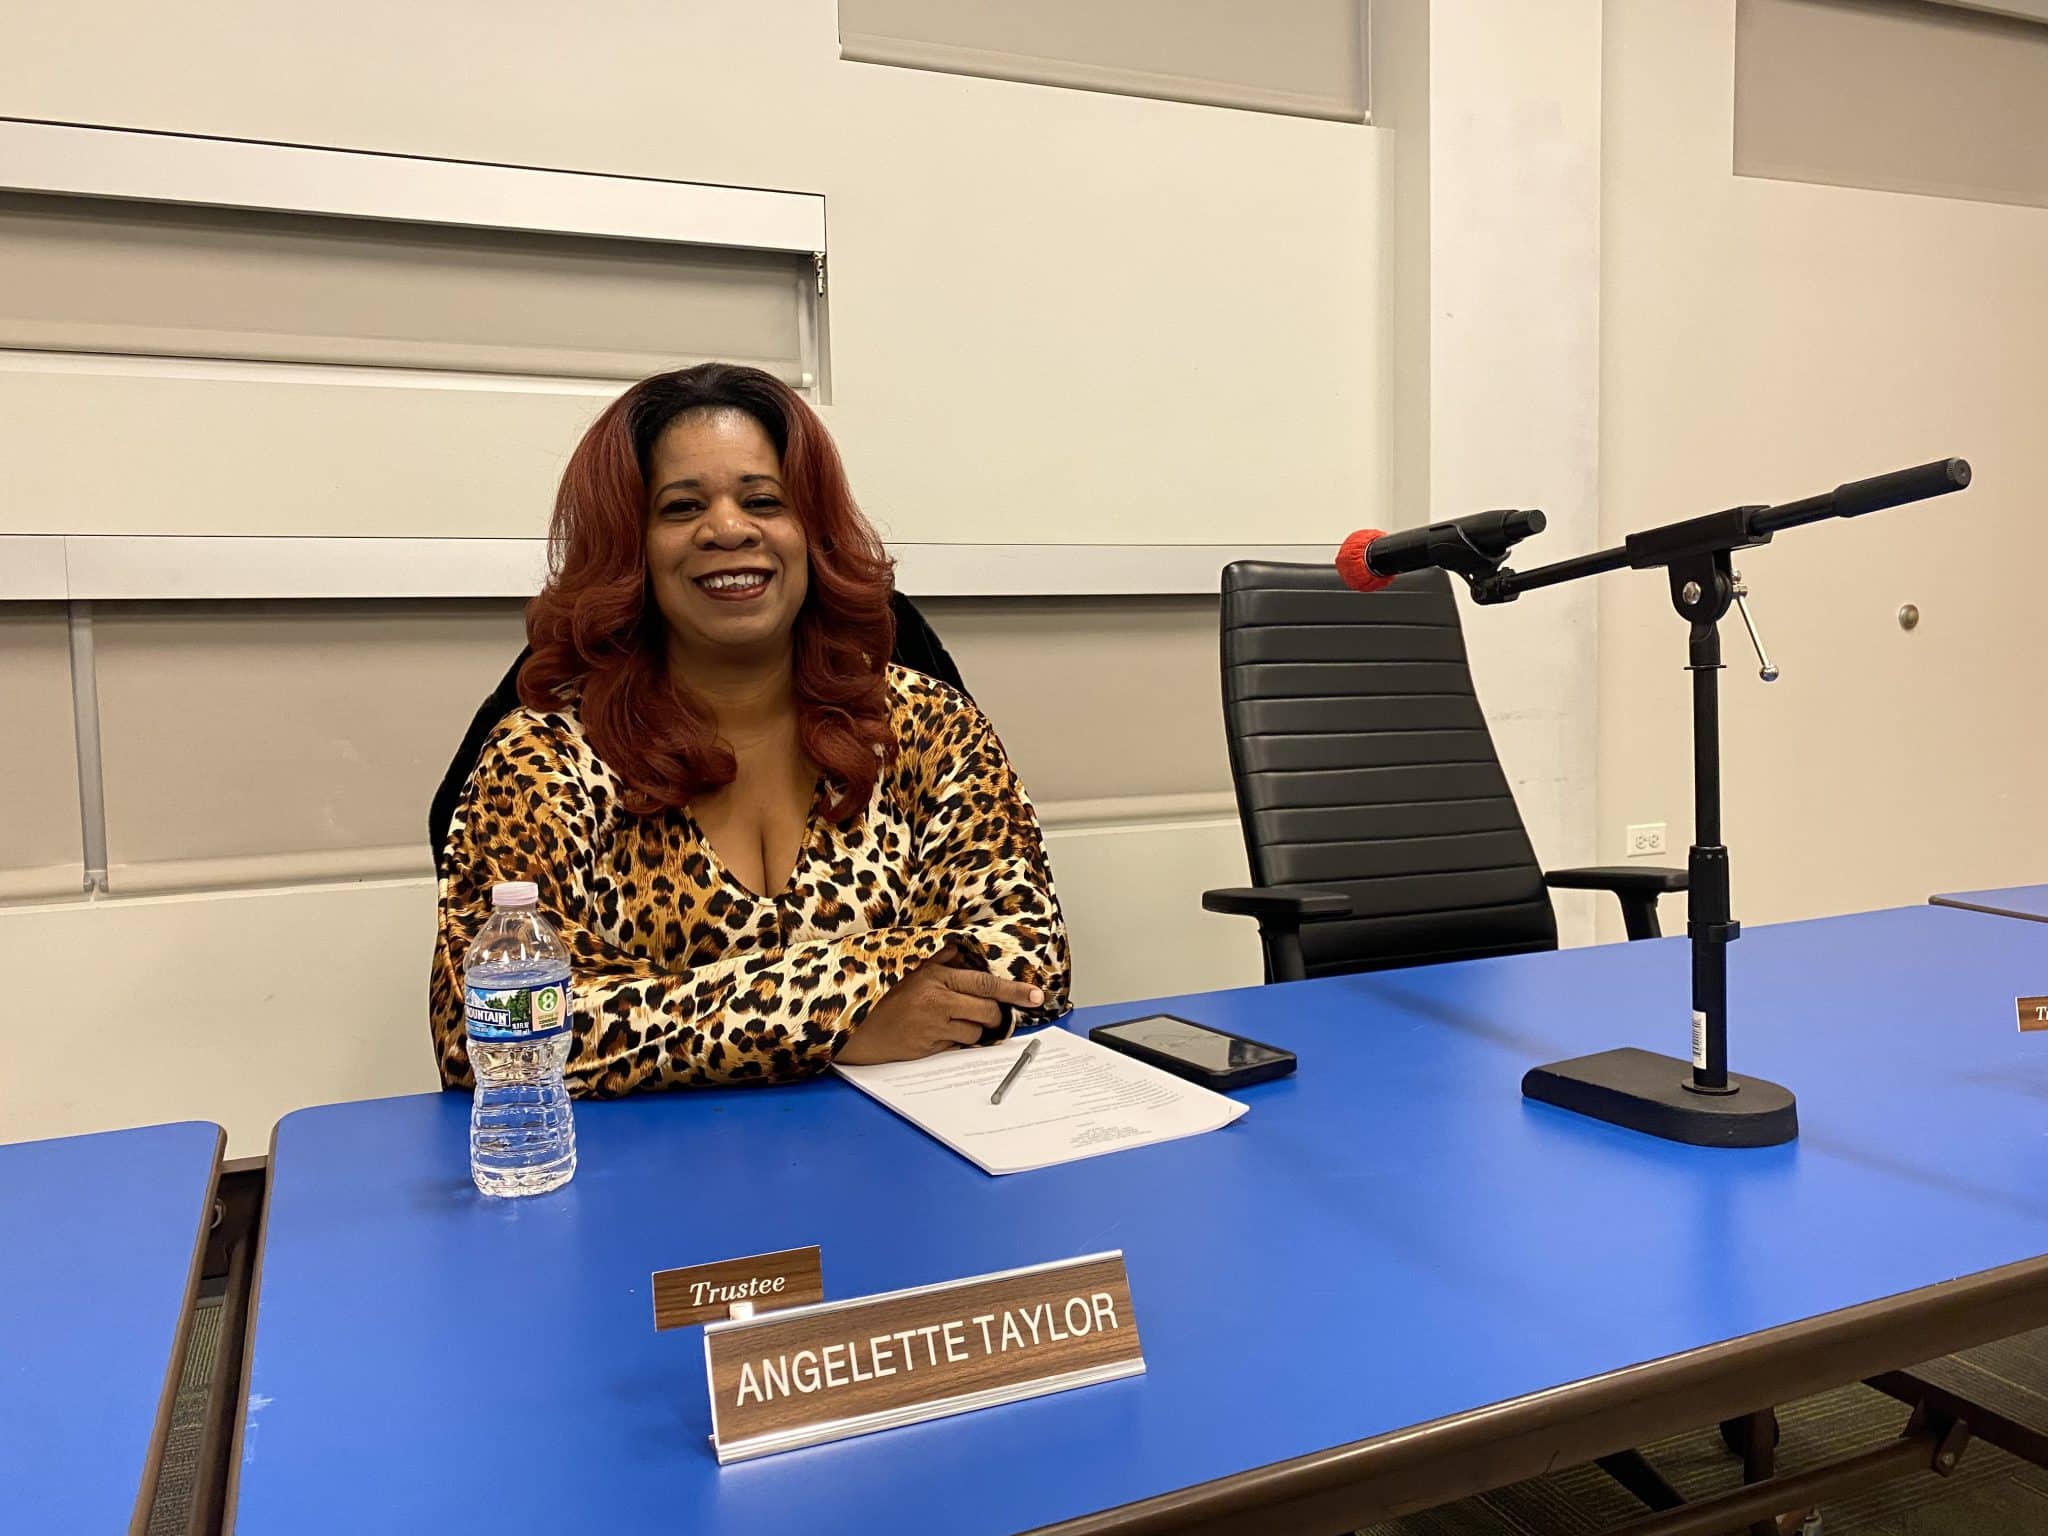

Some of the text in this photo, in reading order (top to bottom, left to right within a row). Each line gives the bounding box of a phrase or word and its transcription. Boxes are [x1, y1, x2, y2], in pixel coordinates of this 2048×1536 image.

[689, 1276, 785, 1306] Trustee
[736, 1292, 1119, 1407] ANGELETTE TAYLOR
